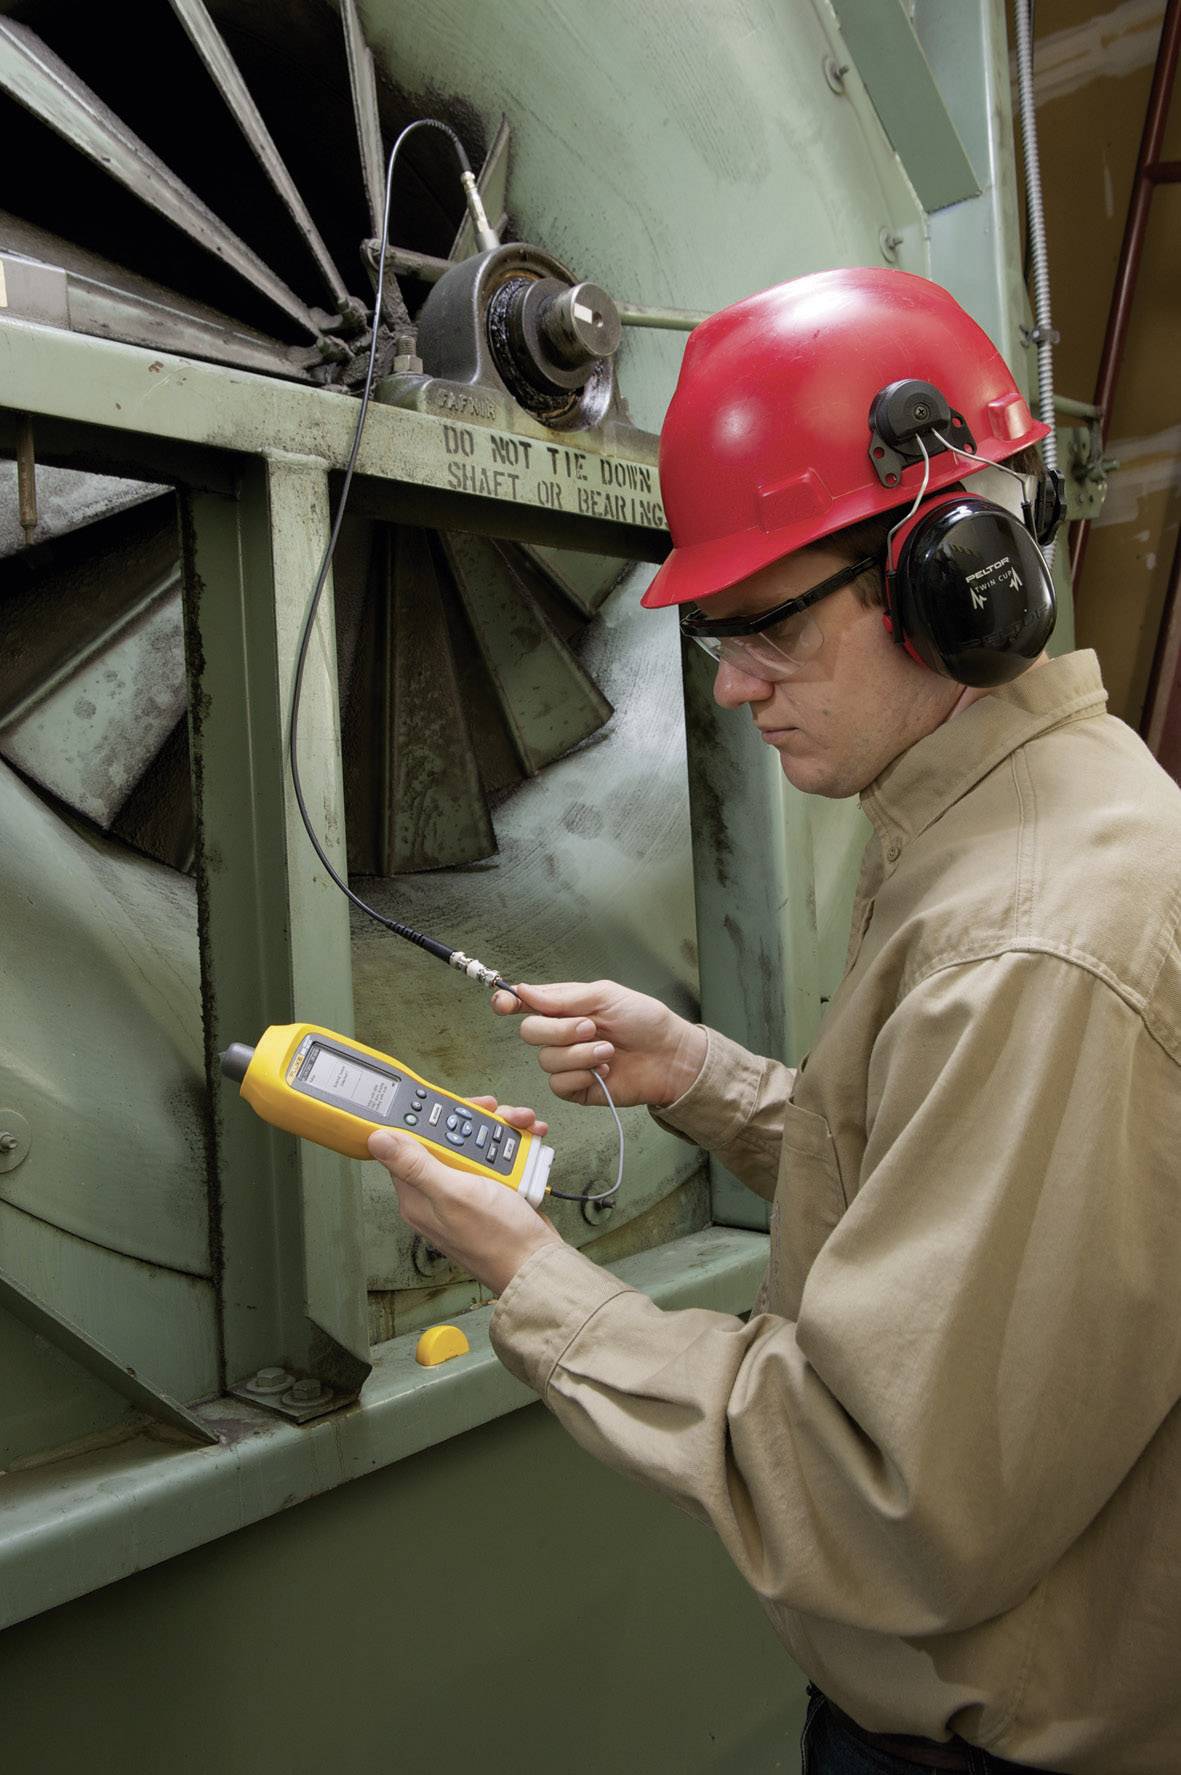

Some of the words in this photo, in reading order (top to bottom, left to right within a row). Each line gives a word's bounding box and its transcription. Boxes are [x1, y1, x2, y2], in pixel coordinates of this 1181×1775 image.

[443, 425, 475, 456] DO
[490, 434, 532, 469] NOT
[547, 447, 588, 481] TIE
[600, 458, 652, 494] DOWN
[448, 461, 519, 501] SHAFT
[537, 480, 563, 510] OR
[577, 487, 669, 529] BEARING
[965, 556, 1010, 583] PELTOR
[974, 578, 996, 593] TWIN
[998, 570, 1013, 582] CUP
